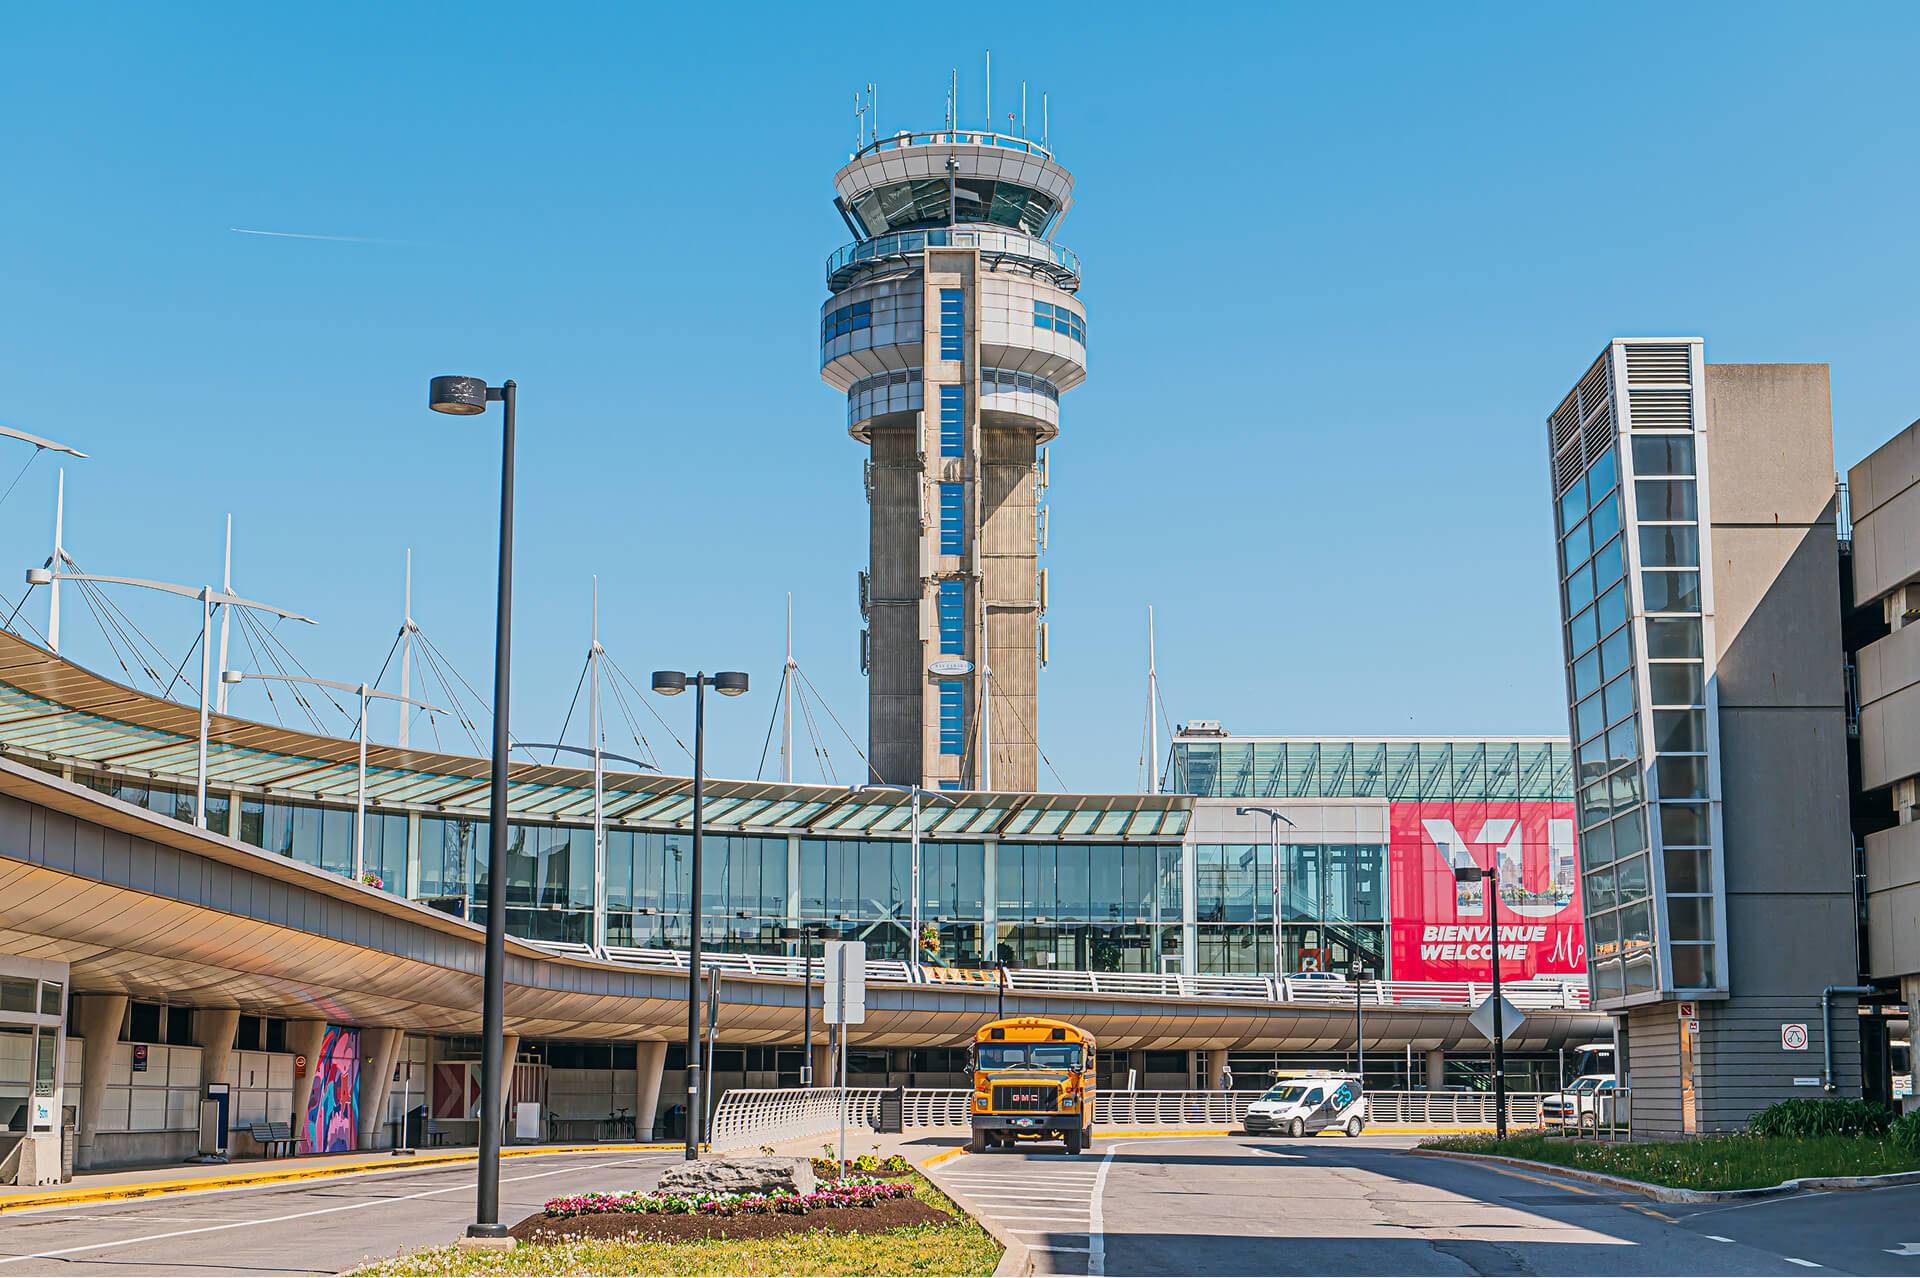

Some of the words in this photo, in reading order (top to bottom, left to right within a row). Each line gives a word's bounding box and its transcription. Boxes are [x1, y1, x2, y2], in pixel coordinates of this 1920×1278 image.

[1423, 926, 1547, 942] BIENVENUE
[1420, 944, 1528, 960] WELCOME
[1012, 1094, 1038, 1102] GMC
